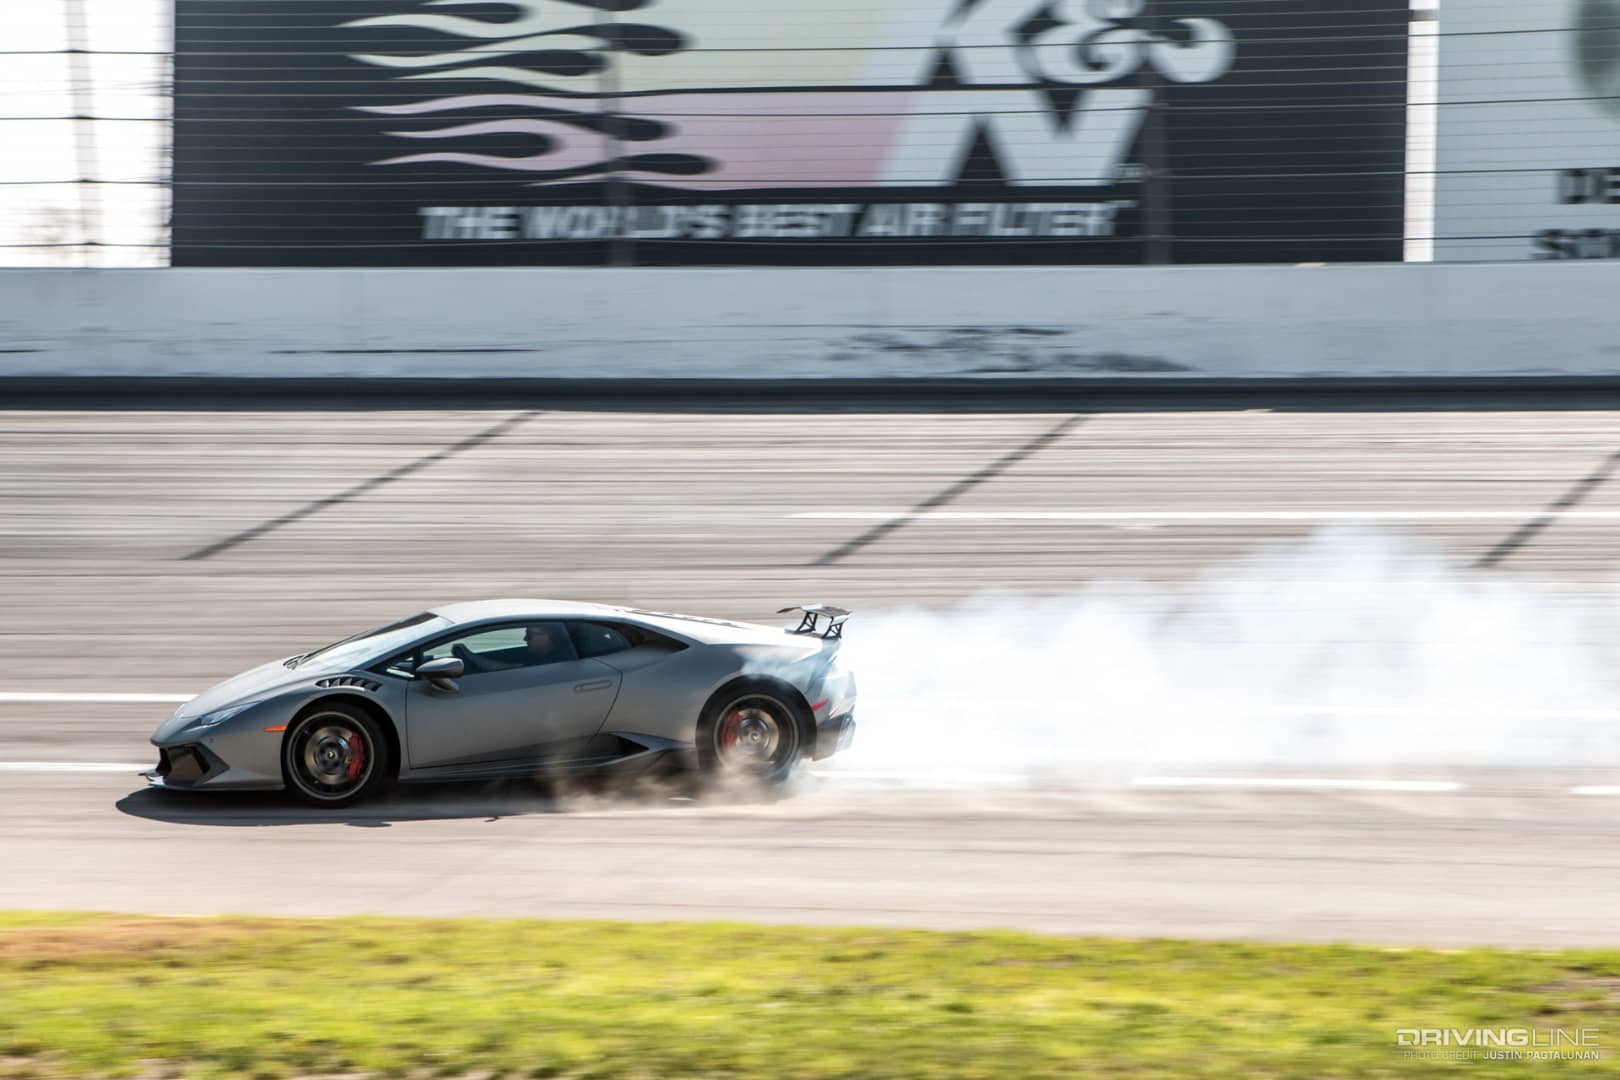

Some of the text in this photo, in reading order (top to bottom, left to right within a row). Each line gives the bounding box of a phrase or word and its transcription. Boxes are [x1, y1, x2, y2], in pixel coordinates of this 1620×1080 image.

[420, 206, 520, 239] THE
[734, 204, 856, 238] BEST
[857, 203, 946, 237] AIR
